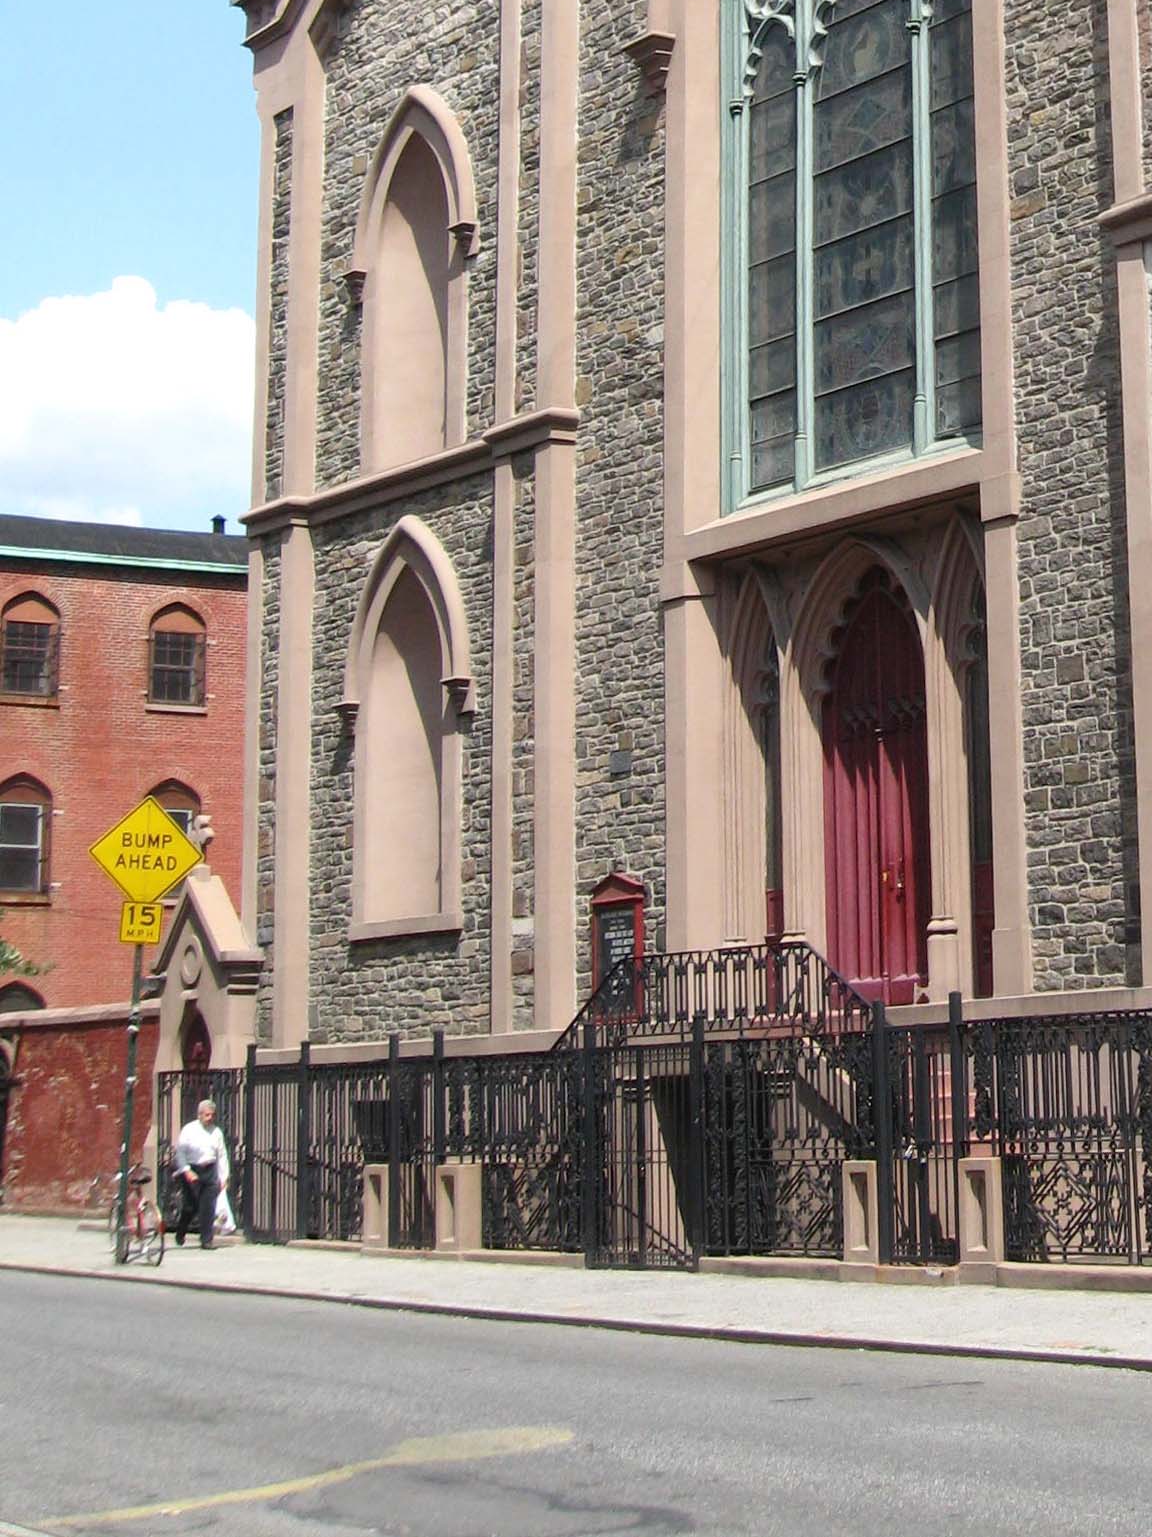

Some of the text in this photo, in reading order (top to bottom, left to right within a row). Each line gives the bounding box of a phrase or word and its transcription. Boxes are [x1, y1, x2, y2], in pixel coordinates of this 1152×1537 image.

[122, 832, 173, 849] BUMP
[115, 854, 178, 871] AHEAD
[128, 906, 156, 926] 15
